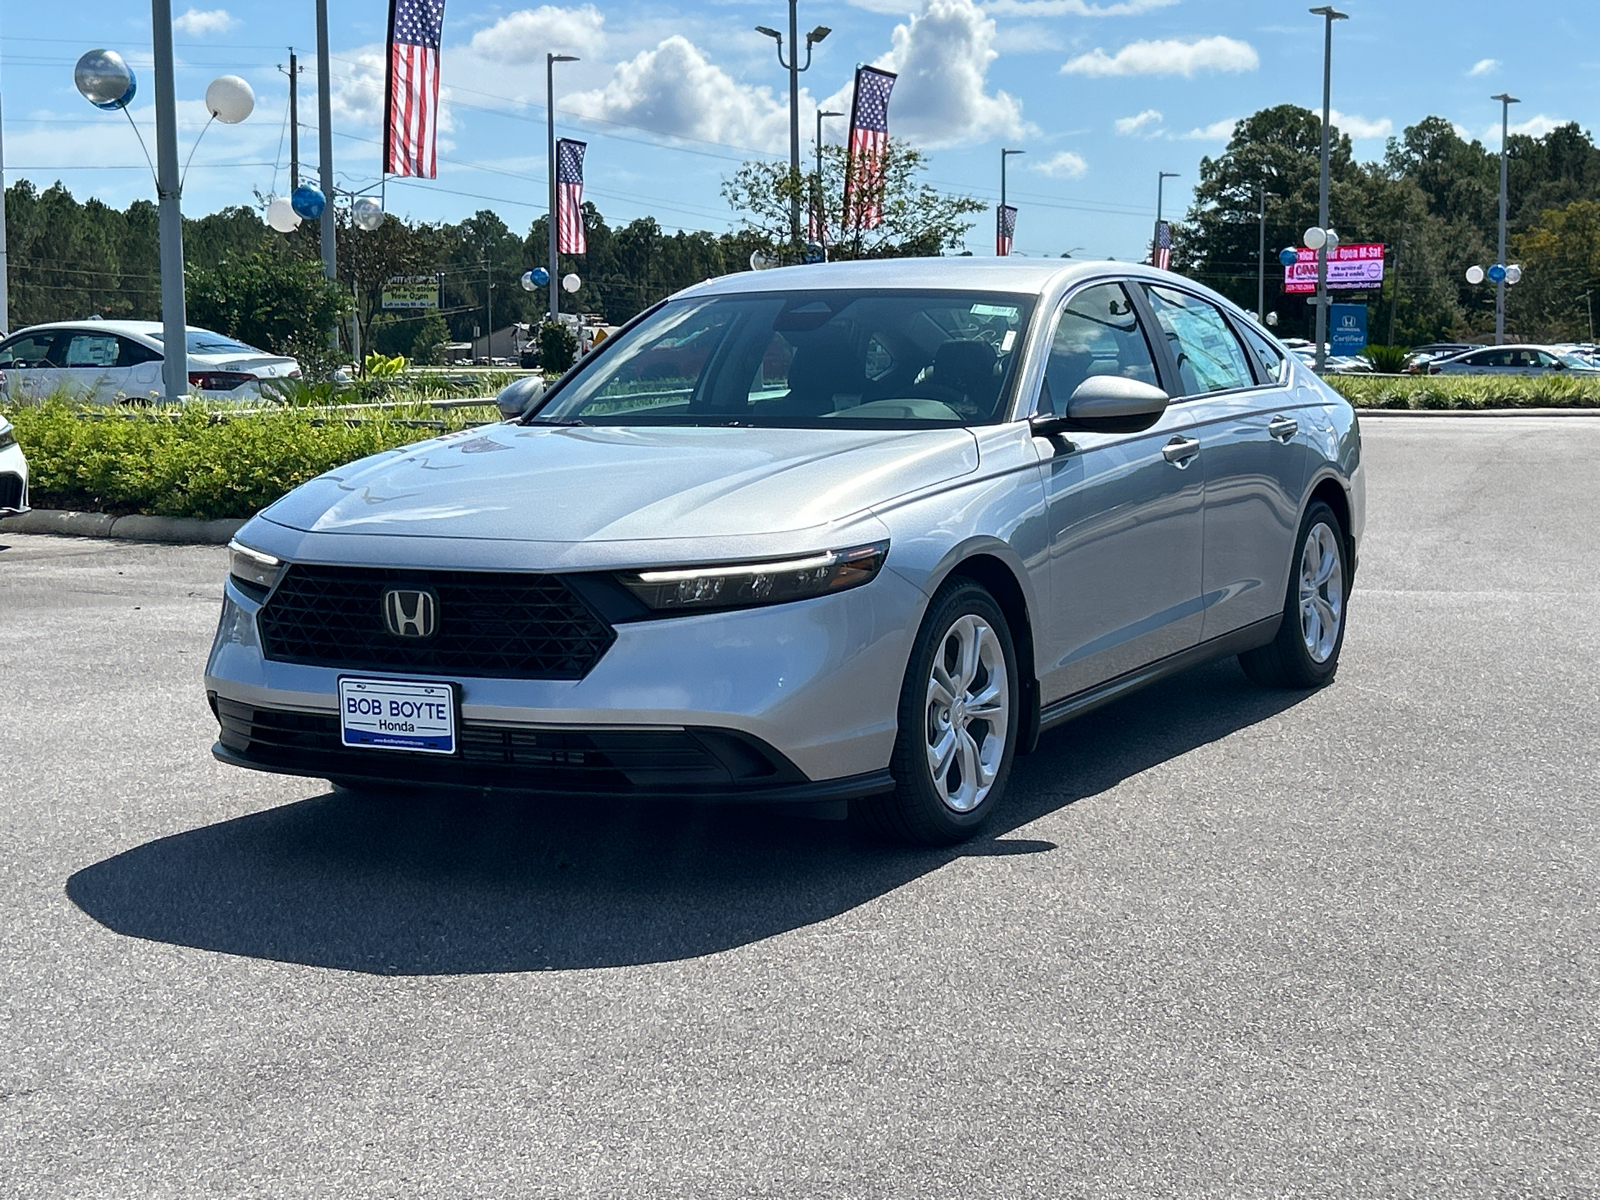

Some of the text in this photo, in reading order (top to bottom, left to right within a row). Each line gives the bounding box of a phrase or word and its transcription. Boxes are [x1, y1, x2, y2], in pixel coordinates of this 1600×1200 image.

[1340, 248, 1358, 260] Open
[1359, 246, 1381, 258] M-Sat
[409, 292, 429, 301] Open
[1332, 334, 1365, 342] Certified
[346, 697, 447, 720] BOB BOYTE
[379, 719, 415, 732] Honda
